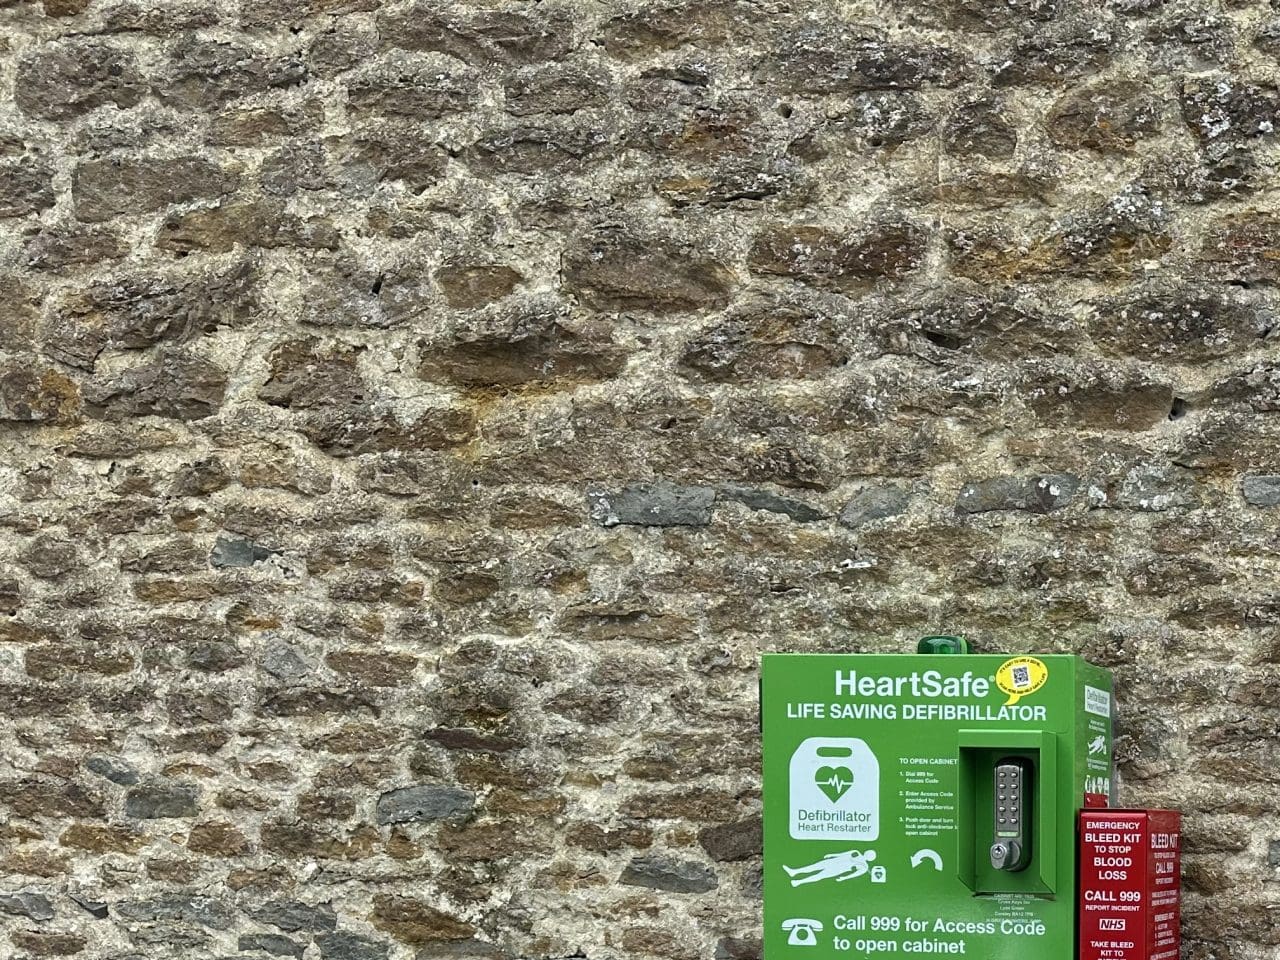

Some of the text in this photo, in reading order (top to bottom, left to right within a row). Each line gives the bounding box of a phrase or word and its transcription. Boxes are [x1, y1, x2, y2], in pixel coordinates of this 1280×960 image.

[787, 703, 1047, 721] LIFE SAVING DEFIBRILLATOR
[798, 809, 872, 822] Defibrillator
[798, 822, 872, 833] Heart Restarter
[1086, 821, 1140, 830] EMERGENCY
[1085, 833, 1141, 843] BLEED KIT
[1151, 833, 1179, 849] BLEED KIT
[1094, 845, 1132, 854] TO STOP
[1093, 857, 1132, 867] BLOOD
[1098, 870, 1127, 880] LOSS
[1084, 890, 1117, 901] CALL
[1119, 890, 1141, 902] 999
[833, 914, 1046, 936] Call 999 for Access Code
[1100, 919, 1125, 930] NHS
[833, 936, 966, 954] to open cabinet
[1090, 940, 1134, 949] TAKE BLEED
